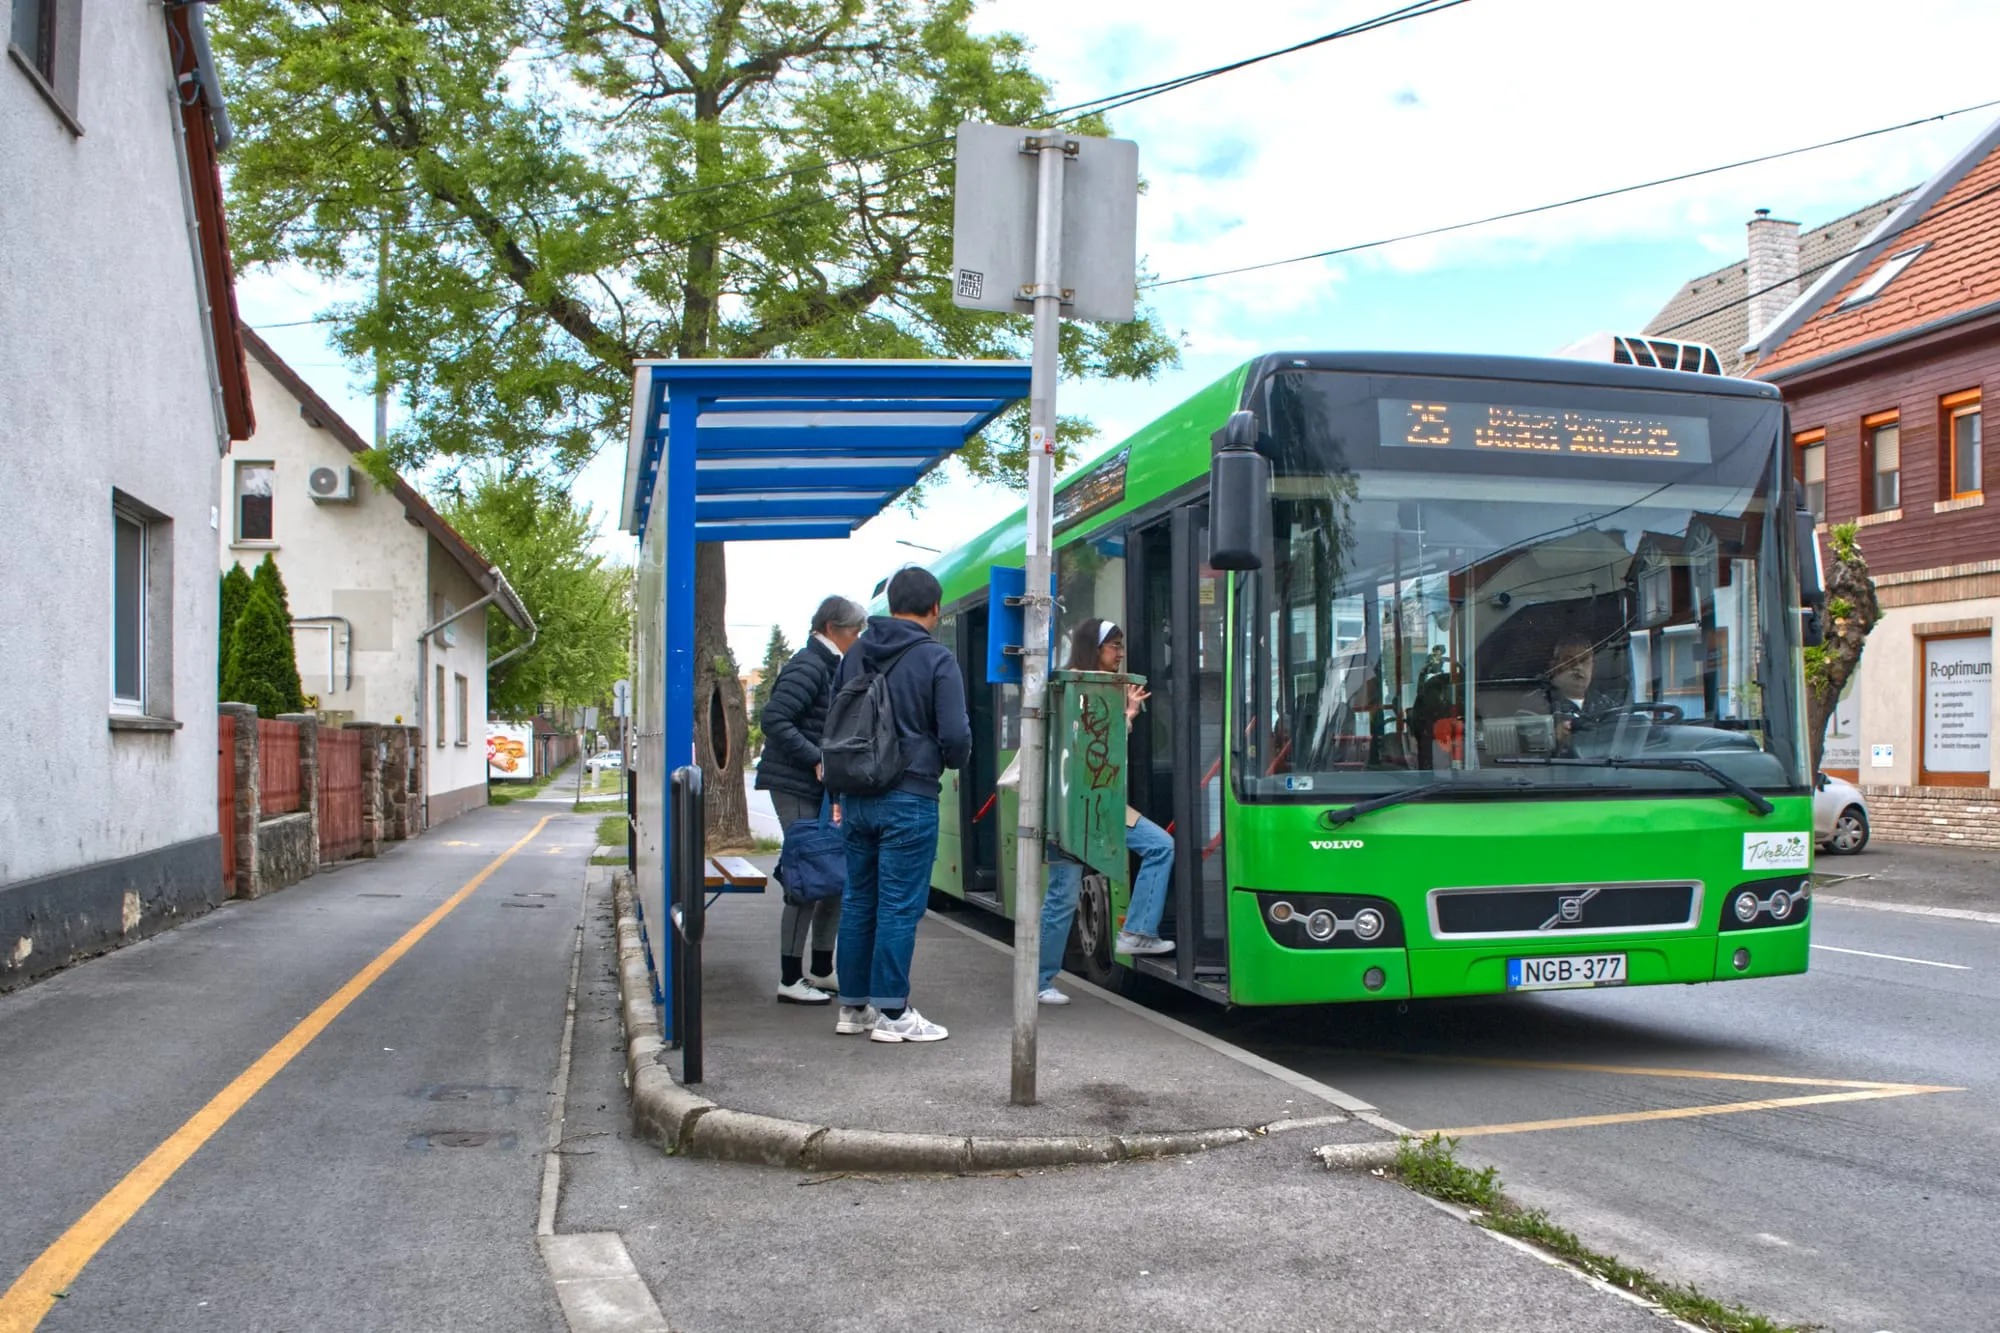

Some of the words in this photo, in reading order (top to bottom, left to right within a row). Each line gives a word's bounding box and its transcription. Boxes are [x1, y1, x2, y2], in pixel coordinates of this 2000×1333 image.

[1930, 660, 1992, 680] R-optimum
[1309, 840, 1364, 849] VOLVO
[1525, 957, 1621, 983] NGB-377
